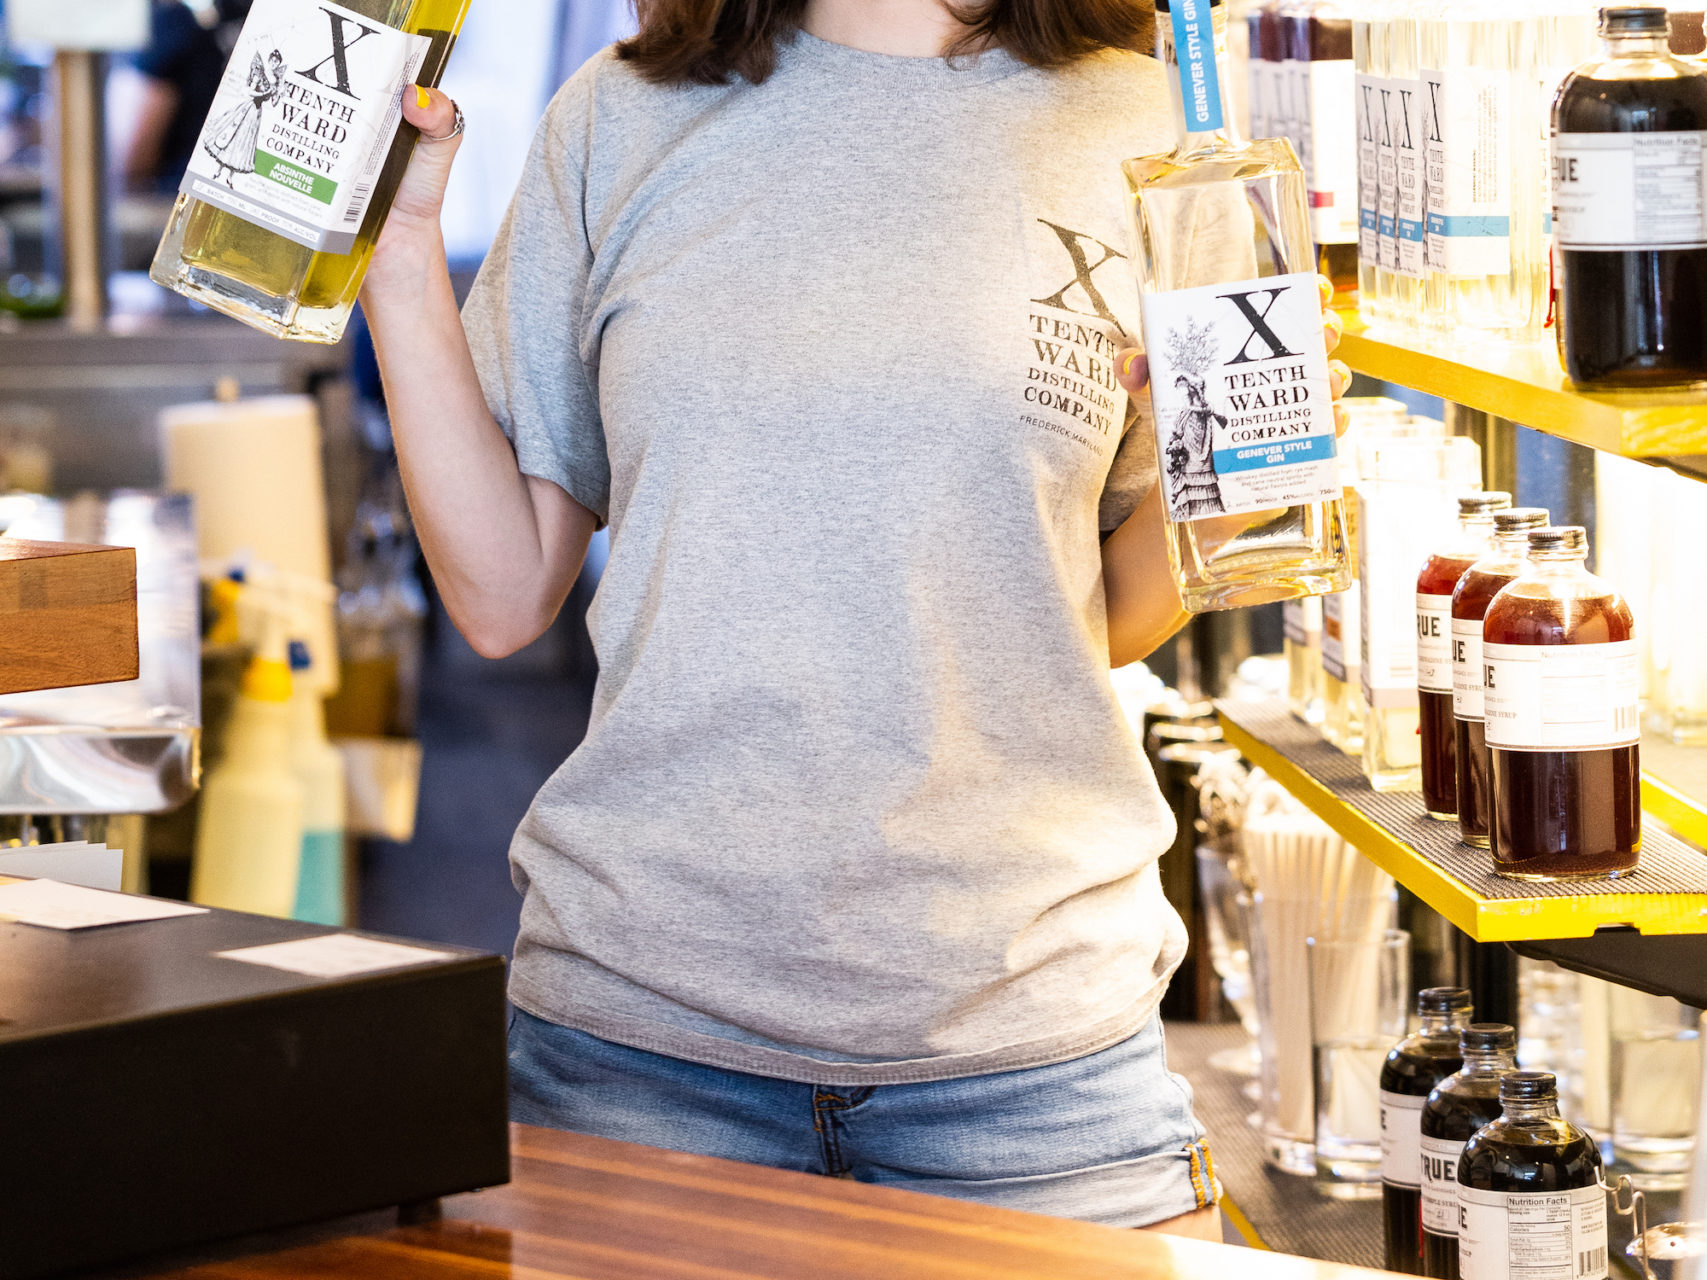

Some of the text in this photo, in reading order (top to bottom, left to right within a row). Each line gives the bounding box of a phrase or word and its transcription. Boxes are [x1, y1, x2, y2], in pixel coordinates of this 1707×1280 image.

[294, 6, 381, 101] X
[1186, 23, 1201, 60] STYLE
[283, 80, 357, 124] TENTH
[1191, 61, 1209, 122] GENEVER
[272, 123, 340, 160] DISTILLING
[281, 103, 347, 144] WARD
[266, 137, 335, 174] COMPANY
[273, 162, 315, 185] ABSINTHE
[269, 170, 314, 195] NOUVELLE
[1030, 218, 1128, 337] X
[1030, 314, 1116, 361] TENTH
[1216, 286, 1305, 366] X
[1030, 338, 1118, 382] WARD
[1225, 365, 1308, 391] TENTH
[1027, 367, 1115, 415] DISTILLING
[1227, 385, 1310, 412] WARD
[1024, 386, 1112, 436] COMPANY
[1230, 408, 1311, 428] DISTILLING
[1231, 422, 1312, 443] COMPANY
[1236, 440, 1313, 460] GENEVER STYLE
[1266, 452, 1285, 464] GIN
[1509, 1197, 1568, 1206] Nutrition Facts
